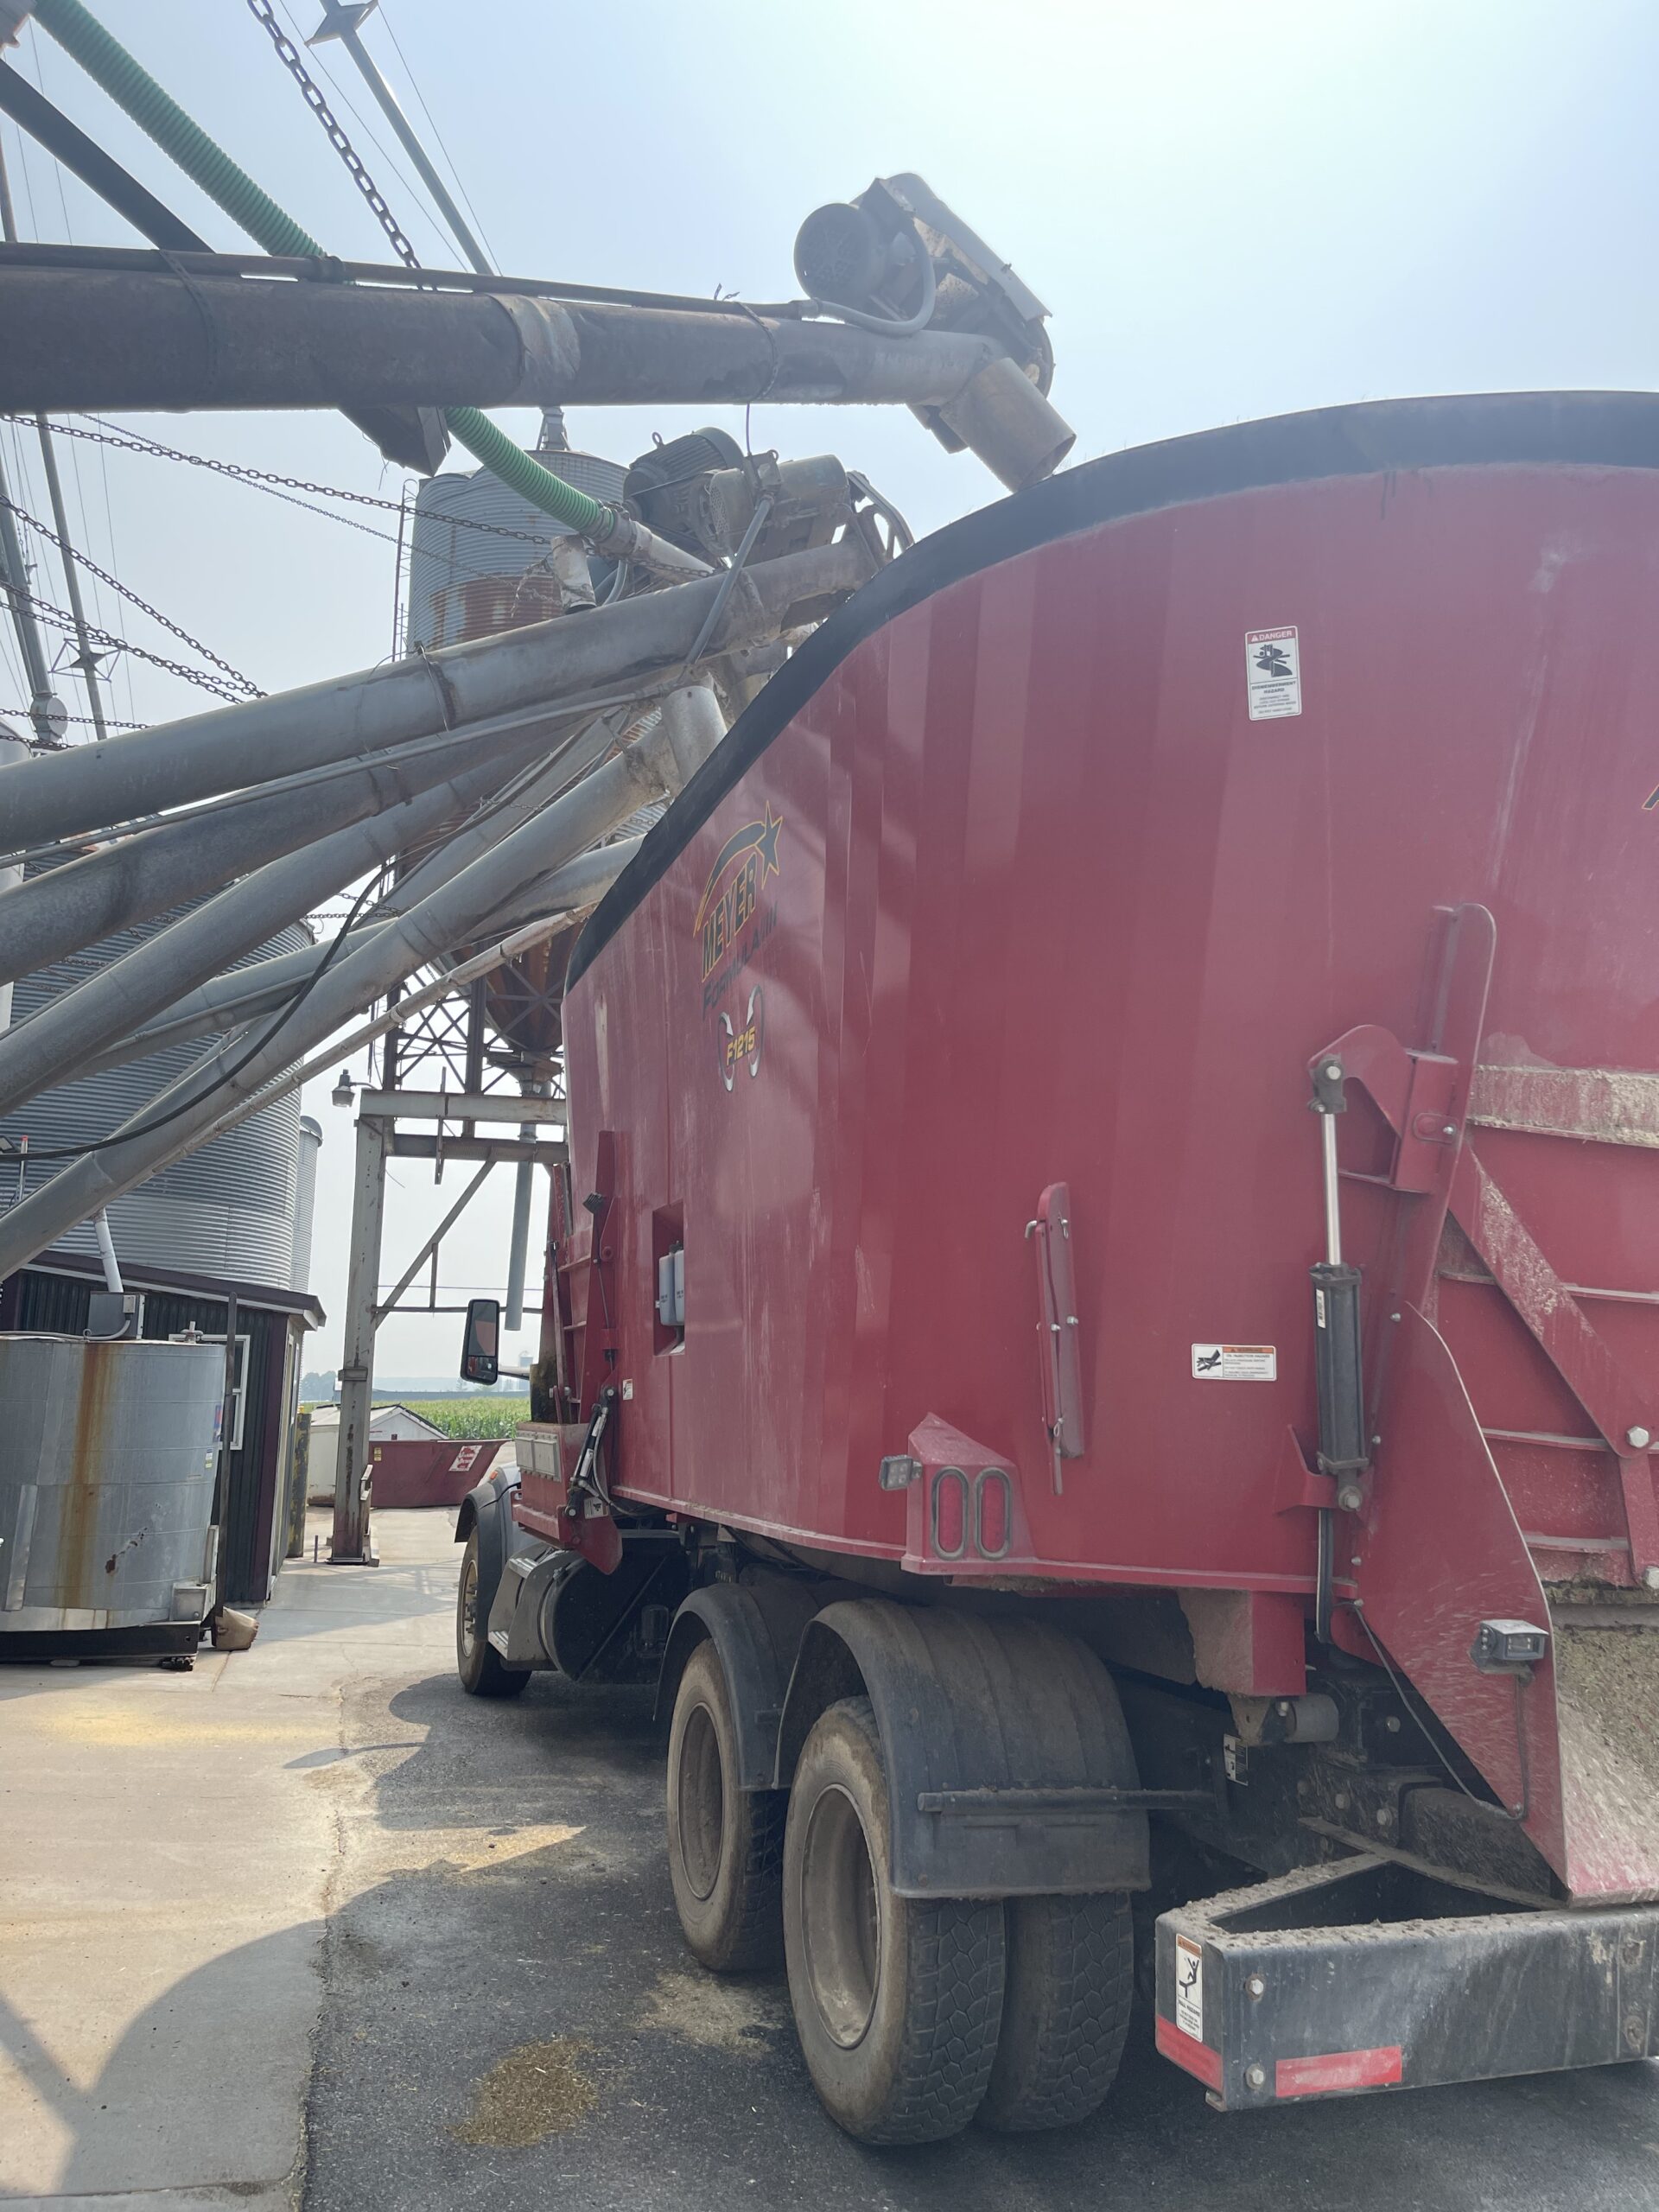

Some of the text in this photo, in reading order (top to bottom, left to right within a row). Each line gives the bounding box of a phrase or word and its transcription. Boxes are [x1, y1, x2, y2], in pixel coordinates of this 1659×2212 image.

[1259, 630, 1293, 641] DANGER
[702, 851, 757, 982] MEYER
[726, 1026, 756, 1066] F1215
